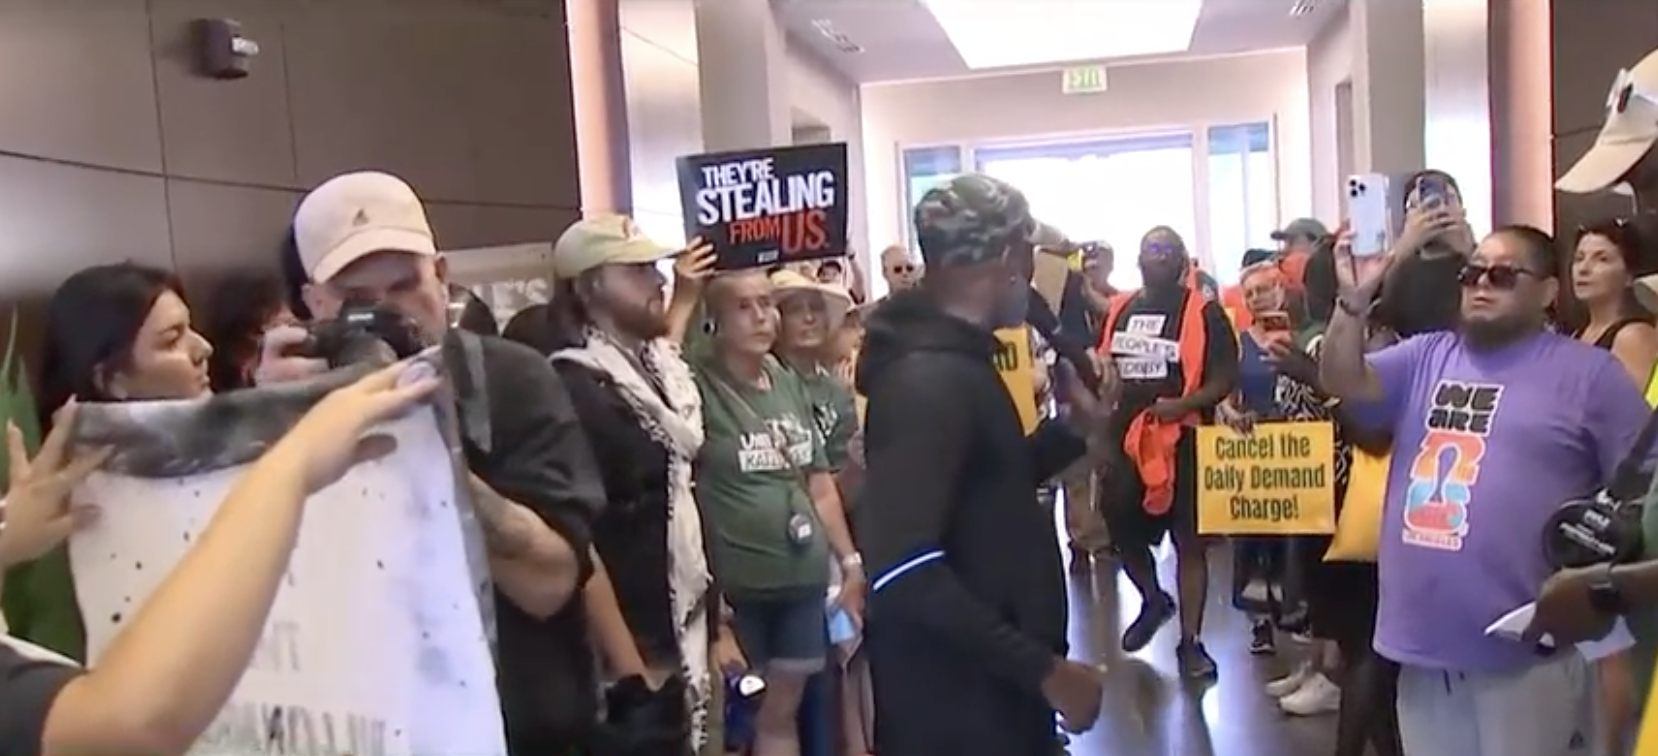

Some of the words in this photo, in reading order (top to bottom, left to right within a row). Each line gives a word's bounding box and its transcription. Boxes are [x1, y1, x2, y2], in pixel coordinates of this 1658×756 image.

[696, 171, 835, 225] STEALING
[729, 216, 780, 245] FROM
[1132, 319, 1160, 332] THE
[1435, 383, 1500, 411] WE
[1214, 433, 1275, 460] Cancel
[1279, 432, 1311, 458] the
[1204, 465, 1245, 492] Daily
[1250, 463, 1326, 490] Demand
[1229, 493, 1299, 522] Charge!
